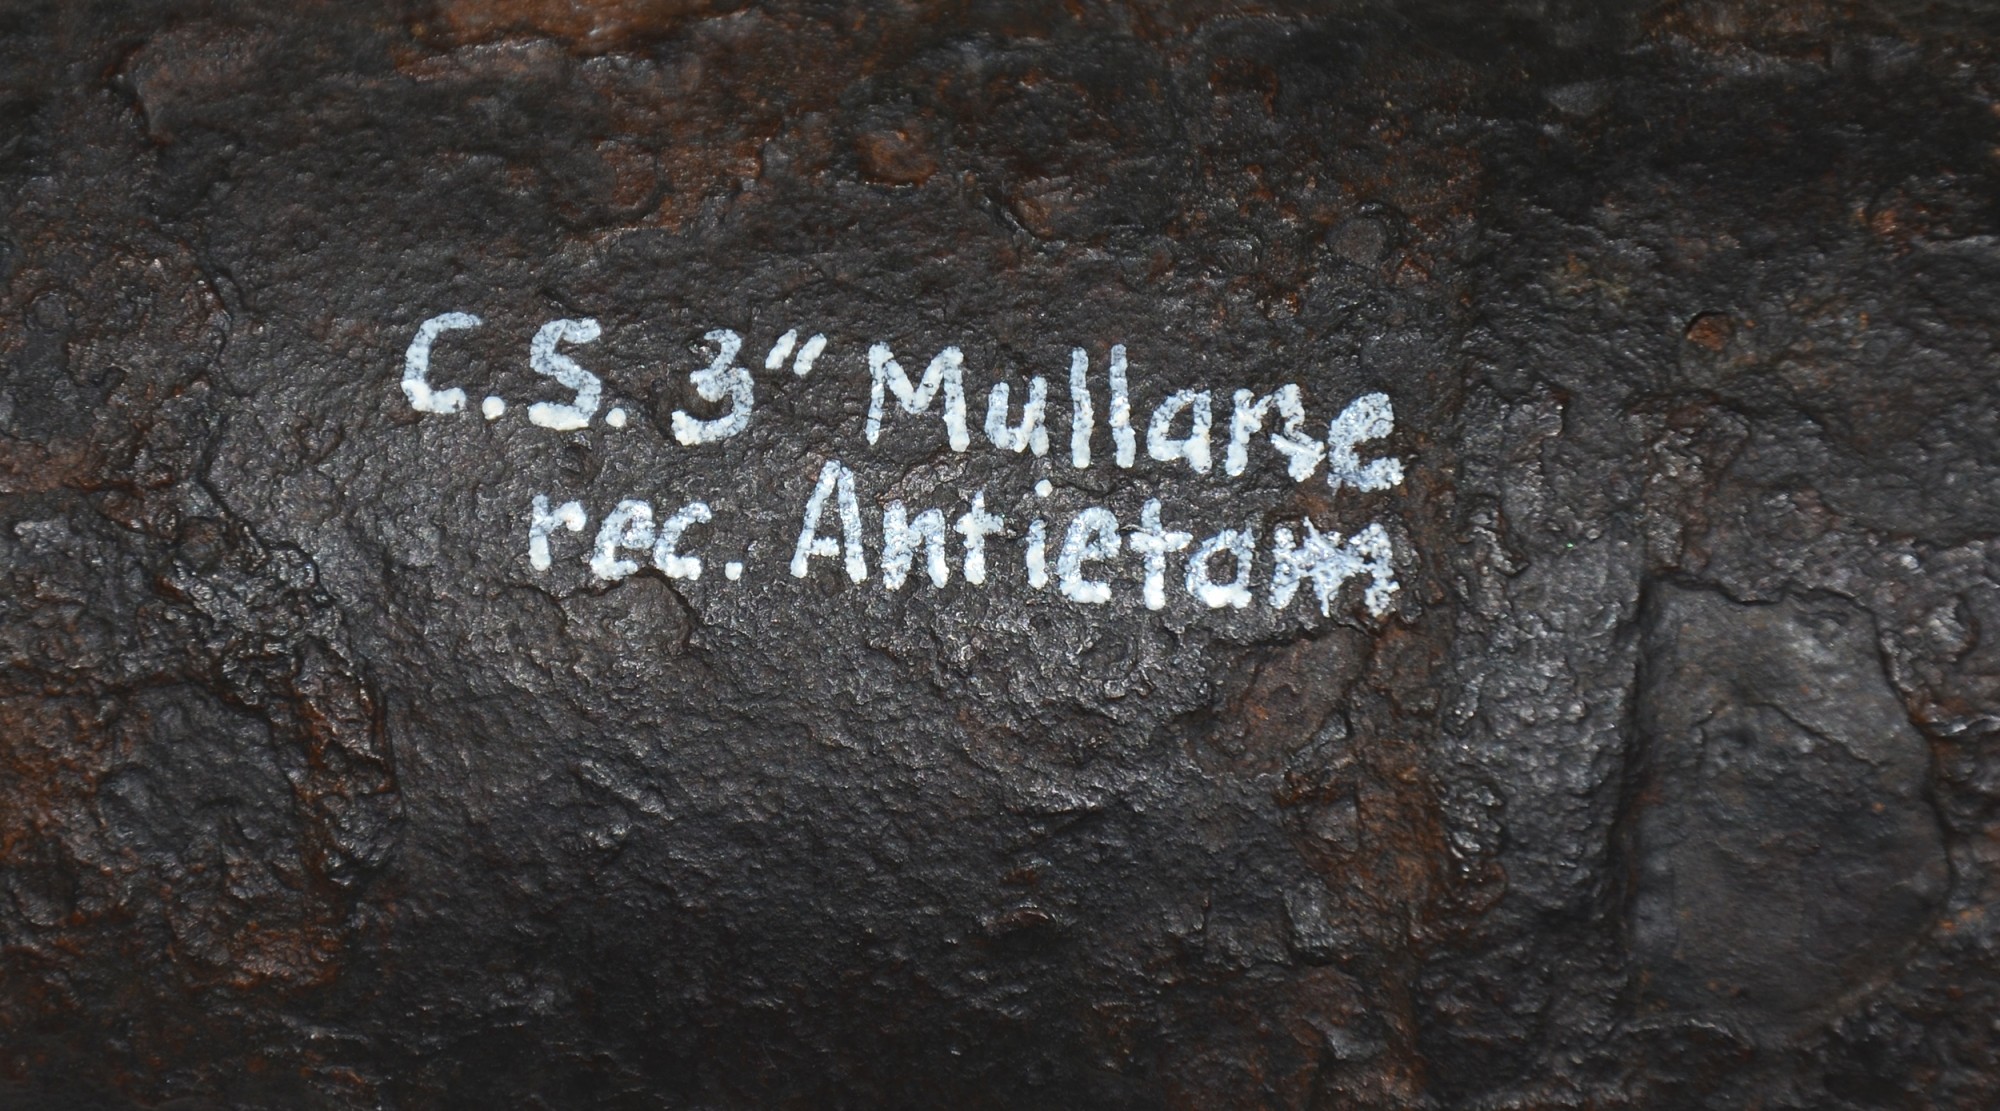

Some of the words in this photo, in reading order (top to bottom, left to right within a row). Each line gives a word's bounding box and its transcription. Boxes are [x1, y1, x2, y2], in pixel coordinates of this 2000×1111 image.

[400, 311, 628, 431] C.S.
[863, 342, 1406, 493] Mullane
[527, 494, 744, 586] rec.
[790, 459, 1401, 618] Antietam
